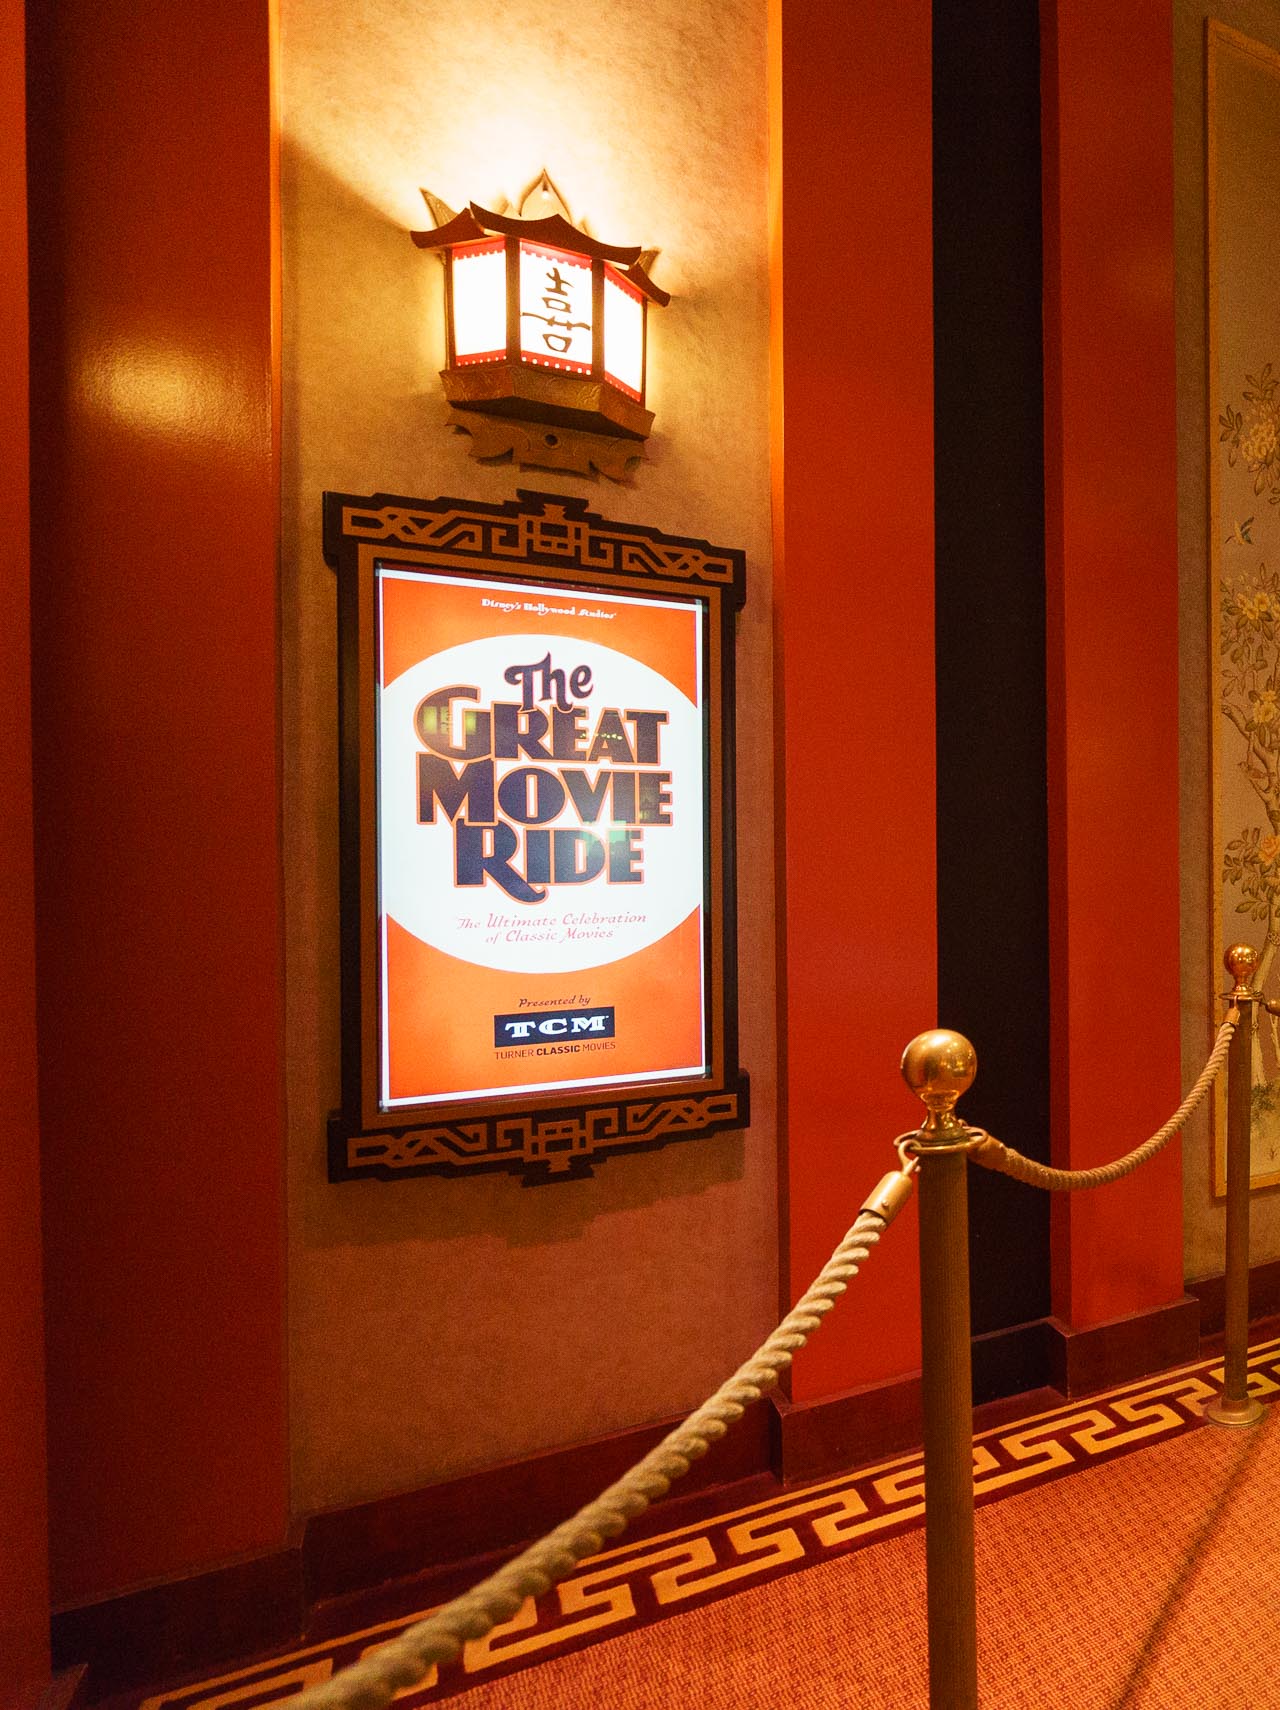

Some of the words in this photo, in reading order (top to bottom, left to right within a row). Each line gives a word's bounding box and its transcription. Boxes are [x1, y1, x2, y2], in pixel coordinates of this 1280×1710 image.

[481, 598, 521, 612] Disney's
[523, 602, 575, 616] Hollywood
[578, 608, 615, 619] Studios
[504, 651, 593, 713] The
[413, 684, 669, 766] GREAT
[416, 751, 673, 826] MOVIE
[453, 816, 645, 905] RIDE
[458, 917, 481, 929] The
[487, 913, 557, 929] Ultimate
[562, 911, 647, 926] Celebration
[486, 933, 499, 944] of
[505, 928, 558, 942] Classic
[560, 926, 614, 943] Movies
[518, 995, 577, 1007] Presented
[578, 994, 591, 1006] by
[504, 1015, 606, 1038] TCM
[494, 1049, 534, 1060] TURNER
[536, 1044, 580, 1056] CLASSIC
[582, 1041, 616, 1052] MOVIES
